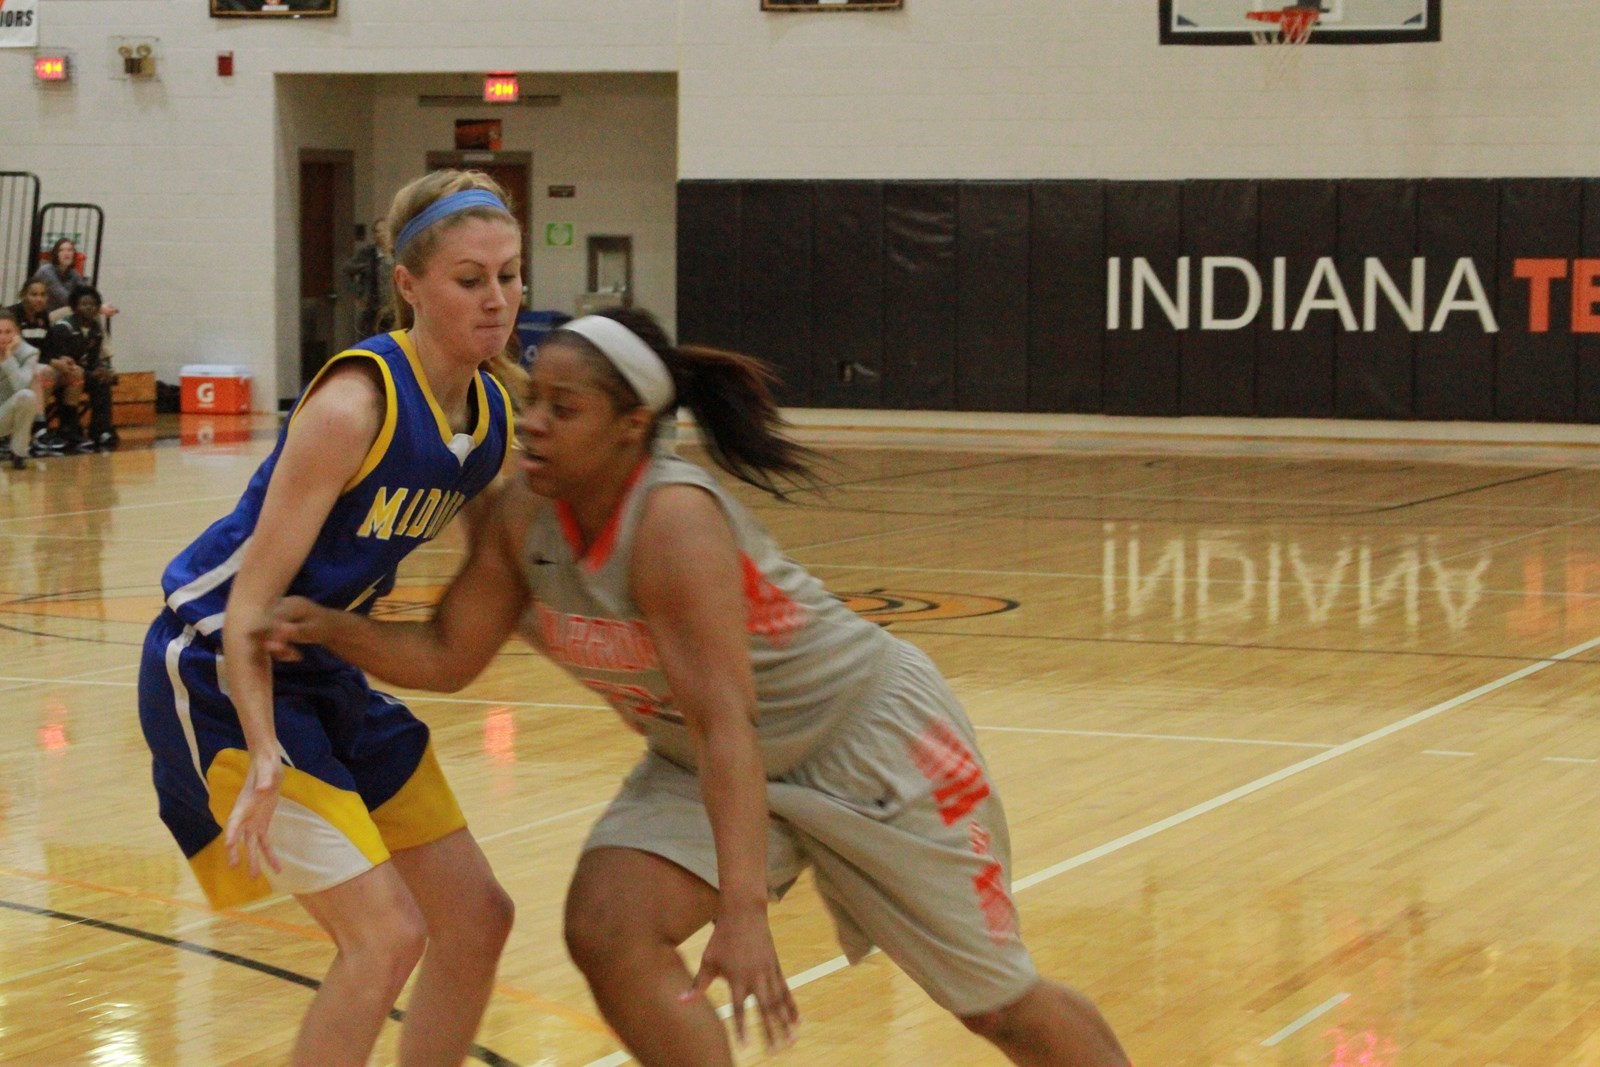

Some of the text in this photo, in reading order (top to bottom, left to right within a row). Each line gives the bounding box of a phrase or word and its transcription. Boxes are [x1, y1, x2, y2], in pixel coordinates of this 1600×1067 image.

[1106, 255, 1600, 334] INDIANA TE
[196, 382, 215, 403] G
